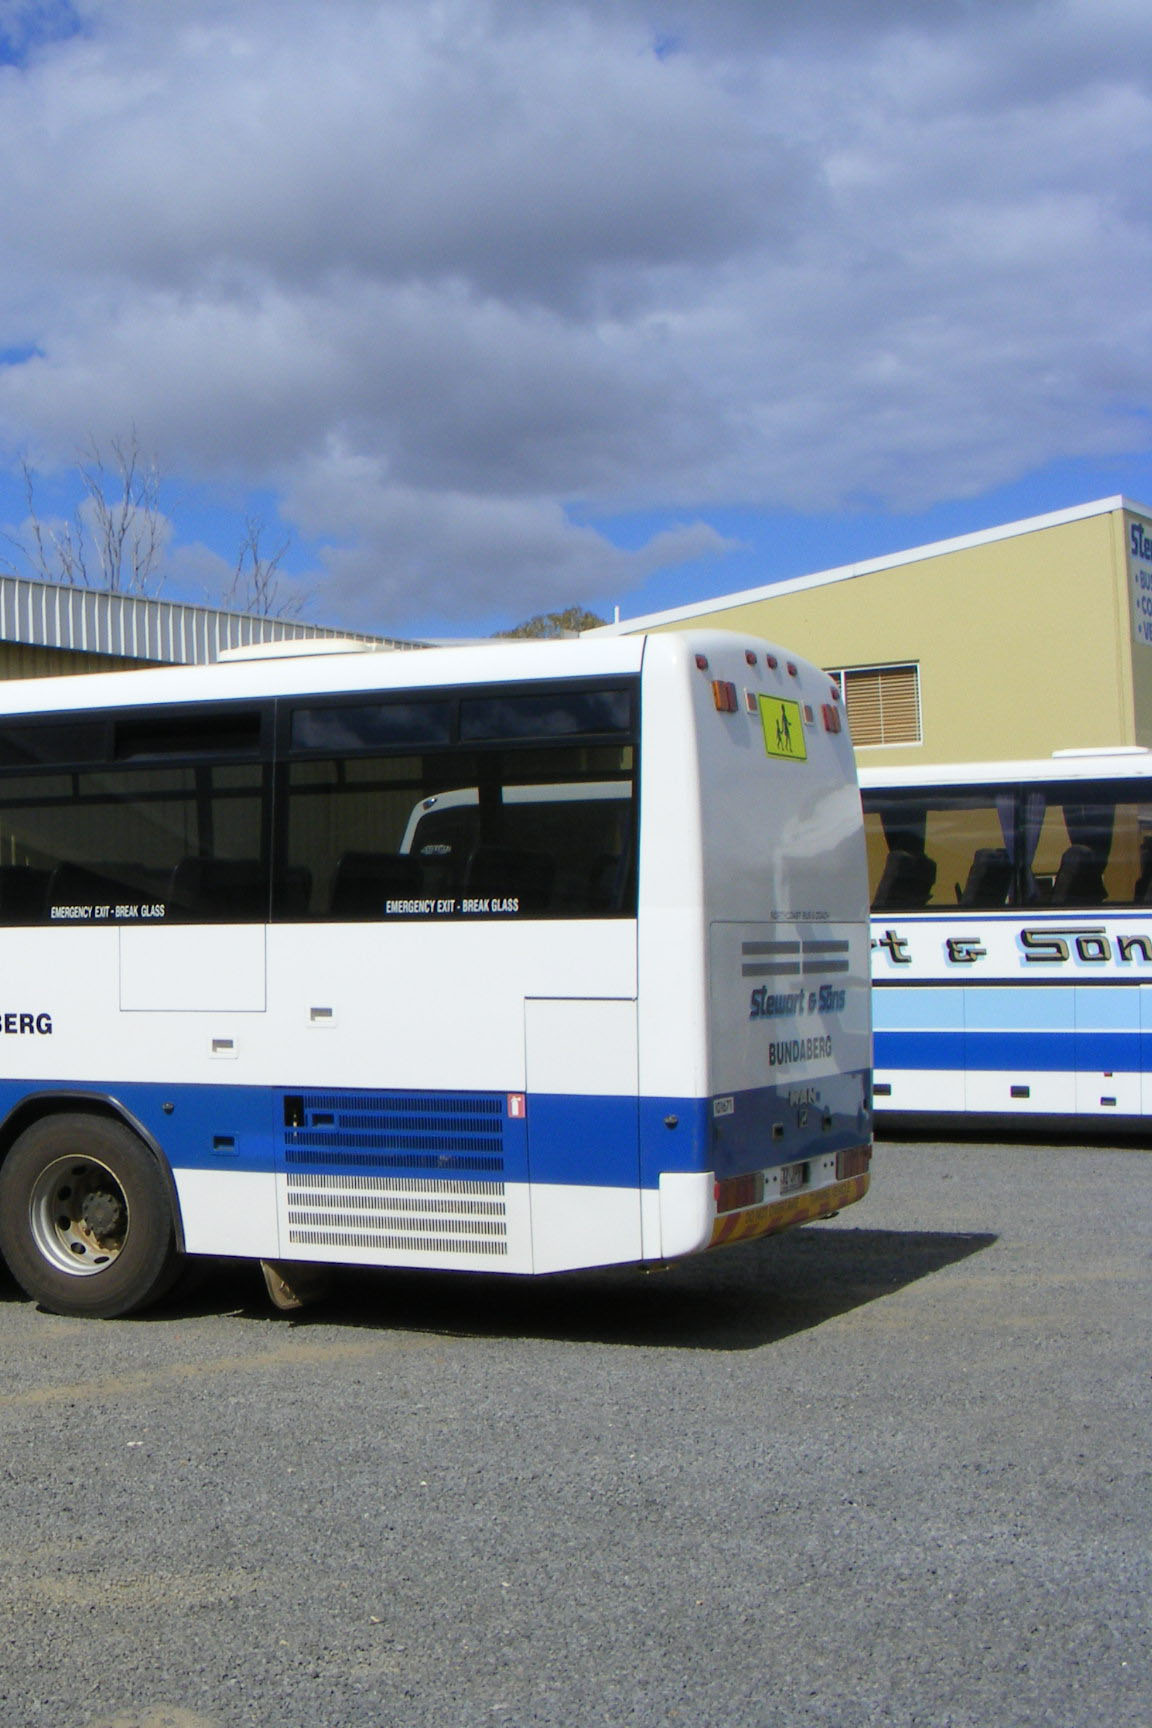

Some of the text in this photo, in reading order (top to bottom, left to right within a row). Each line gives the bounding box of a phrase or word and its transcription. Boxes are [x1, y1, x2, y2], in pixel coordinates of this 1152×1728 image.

[51, 906, 93, 918] EMERGENCY
[94, 906, 110, 918] EXIT
[115, 905, 138, 917] BREAK
[140, 904, 165, 917] GLASS
[386, 900, 436, 913] EMERGENCY
[436, 900, 455, 912] EXIT
[462, 899, 489, 912] BREAK
[491, 898, 519, 911] GLASS
[946, 937, 986, 963] &
[749, 985, 805, 1019] Stewart
[818, 984, 845, 1013] Sons
[768, 1035, 832, 1066] BUNDABERG
